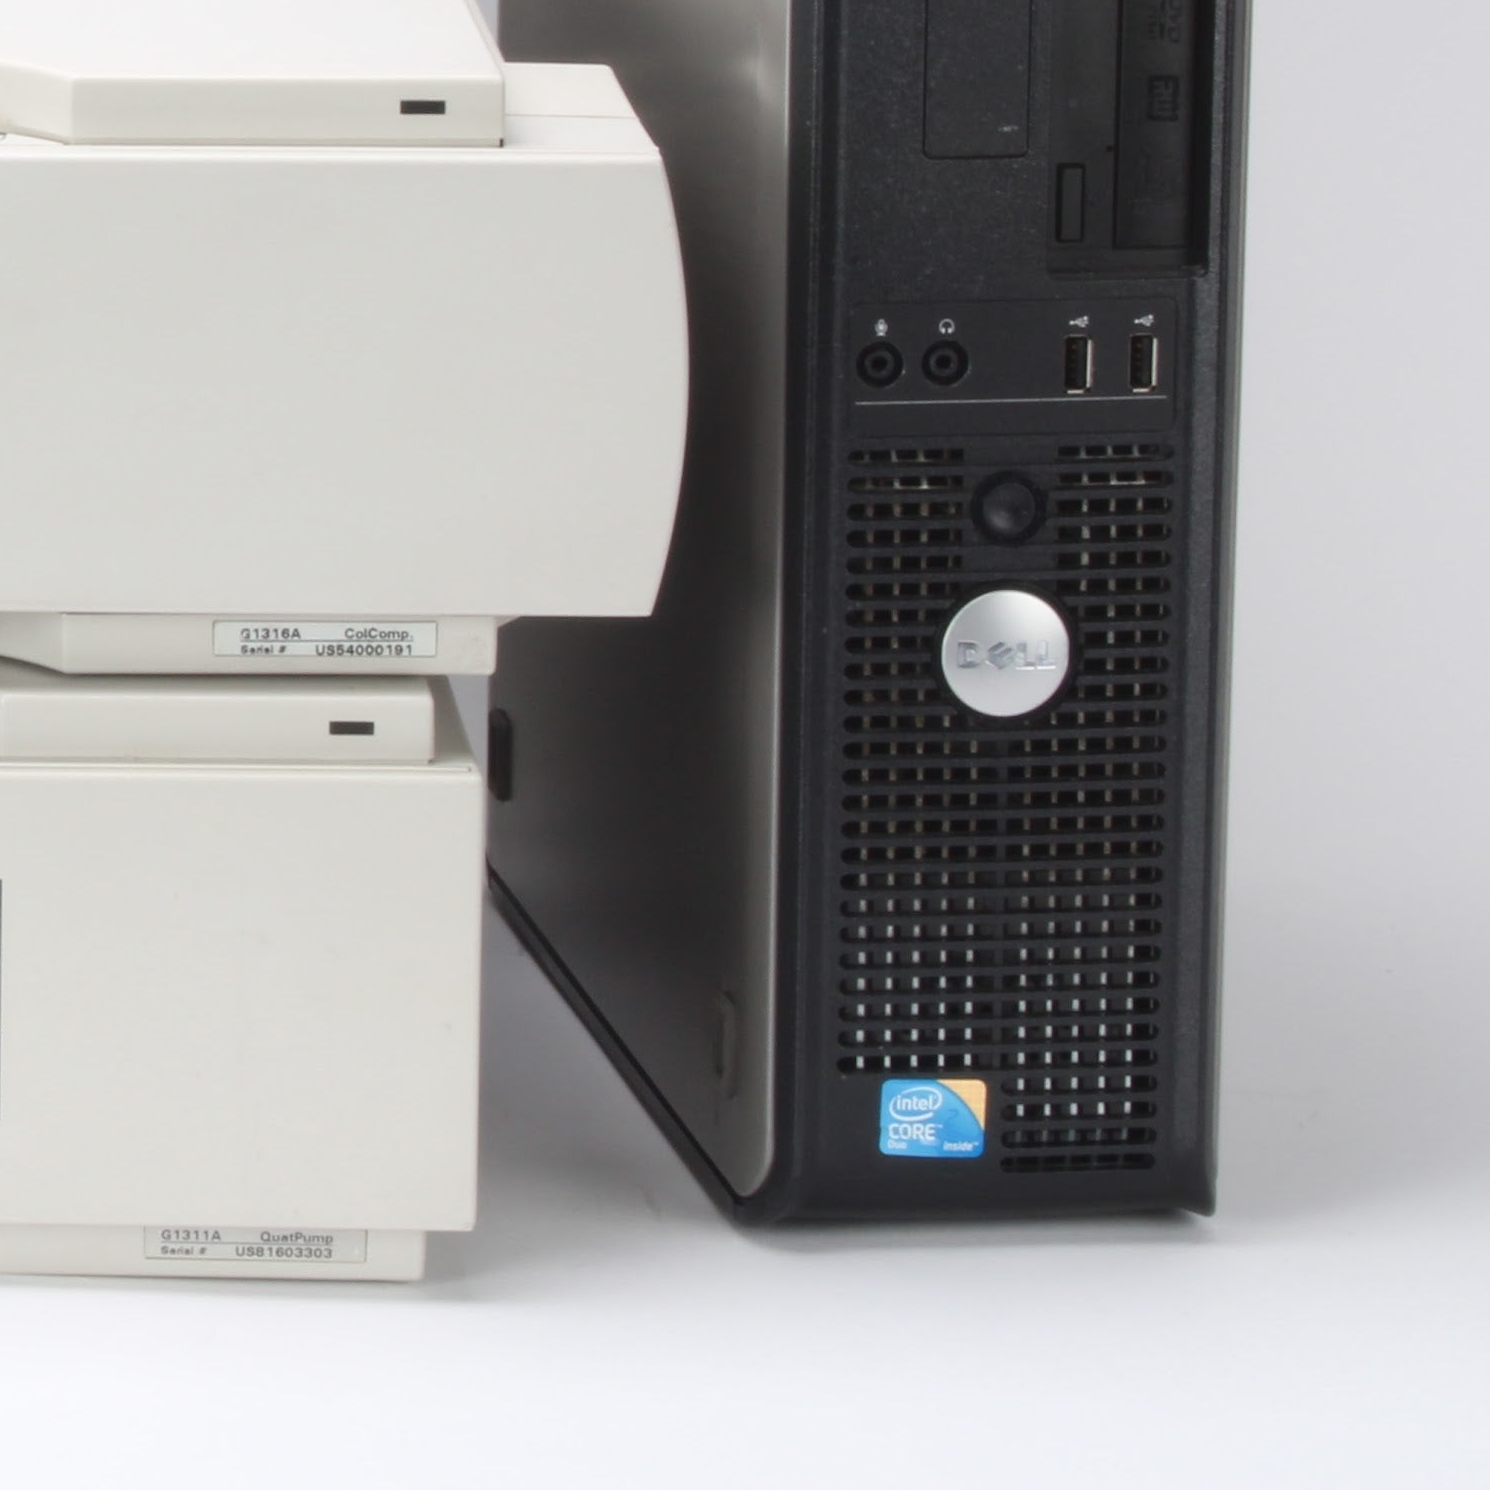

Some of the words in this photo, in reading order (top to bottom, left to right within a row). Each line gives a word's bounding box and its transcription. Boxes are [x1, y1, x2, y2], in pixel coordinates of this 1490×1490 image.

[240, 627, 301, 640] G1316A
[344, 627, 414, 641] ColComp.
[240, 644, 274, 654] Serial
[277, 645, 287, 654] #
[315, 644, 413, 657] US54000191
[956, 640, 1058, 671] DELL
[895, 1094, 934, 1111] intel
[888, 1123, 936, 1141] CORE
[160, 1229, 222, 1241] G1311A
[259, 1230, 334, 1245] QuatPump
[160, 1245, 194, 1256] Serial
[198, 1246, 207, 1255] #
